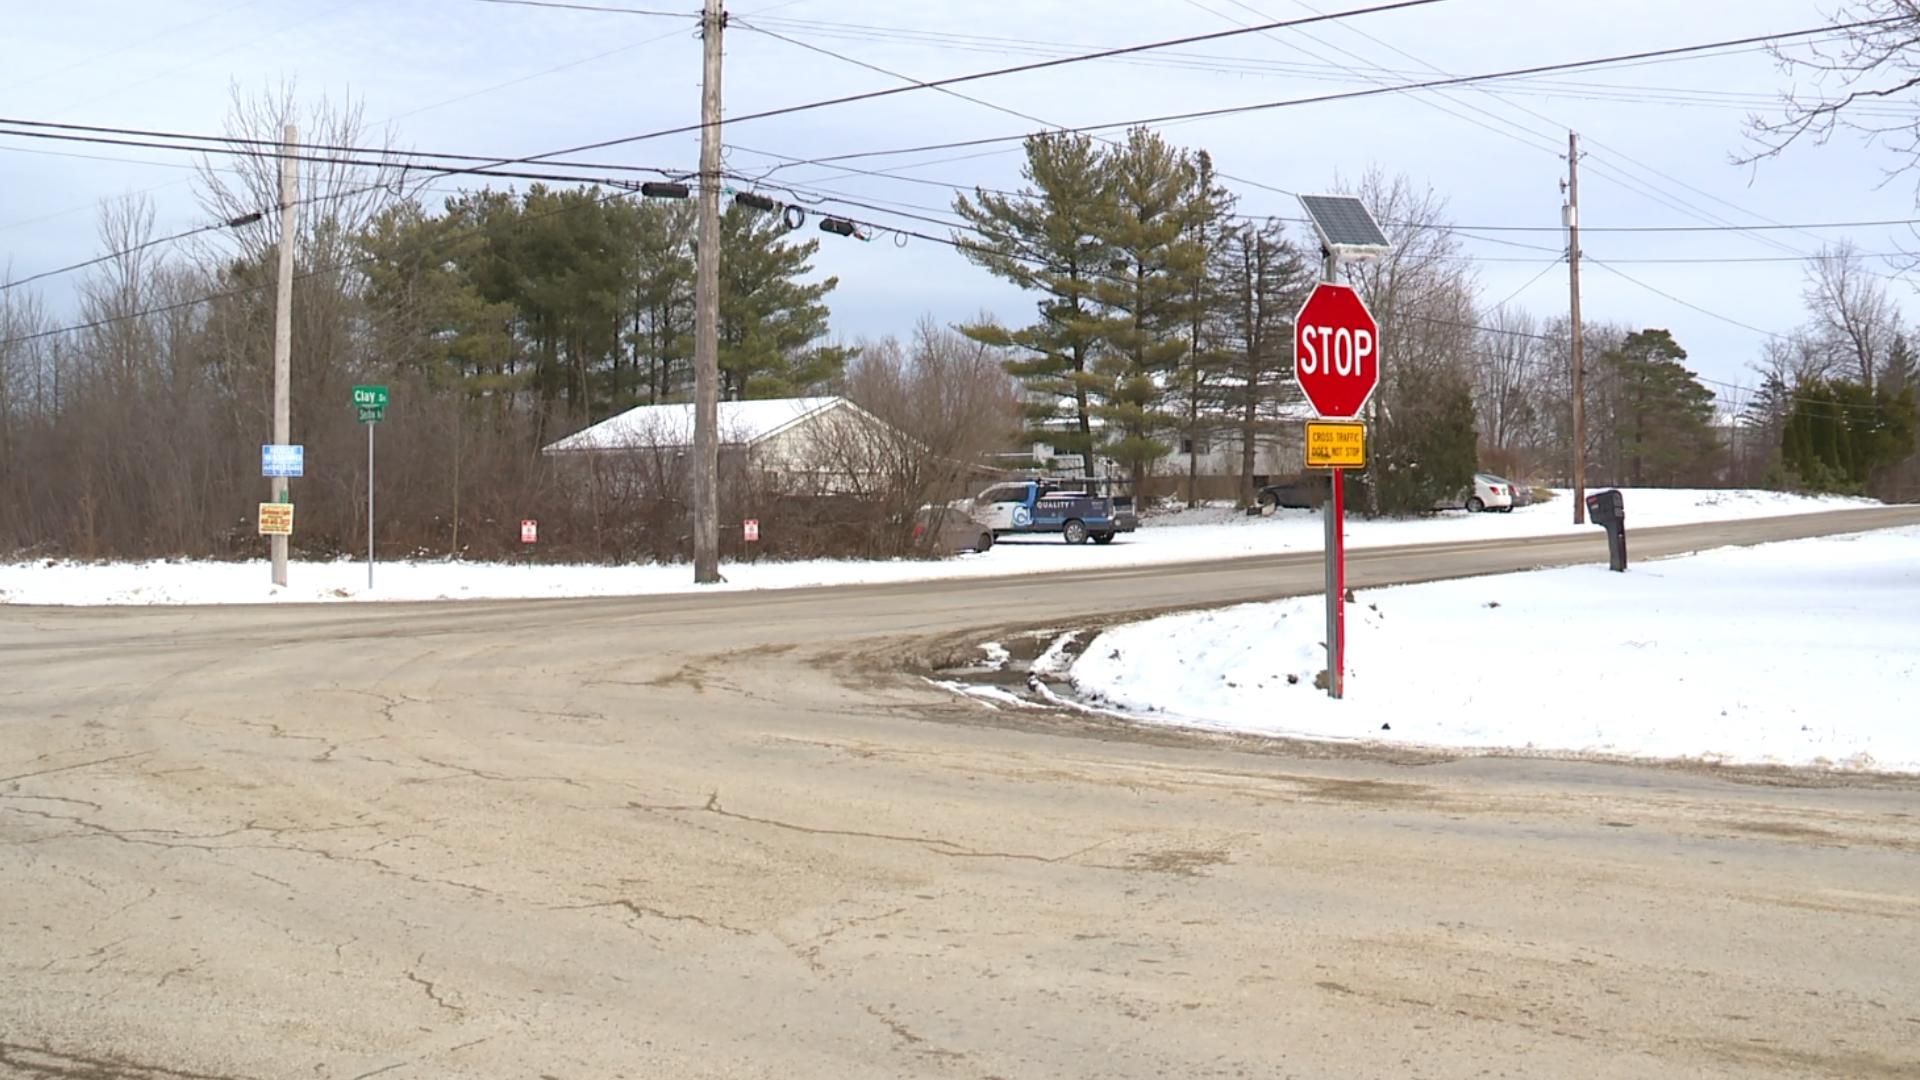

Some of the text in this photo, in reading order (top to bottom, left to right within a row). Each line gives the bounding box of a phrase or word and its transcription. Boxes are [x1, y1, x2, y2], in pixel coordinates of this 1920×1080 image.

[1300, 324, 1373, 377] STOP
[354, 389, 376, 404] Clay
[1312, 431, 1361, 443] CROSS TRAFFIC
[1311, 446, 1360, 457] DOES NOT STOP
[1036, 501, 1069, 509] QUALITY
